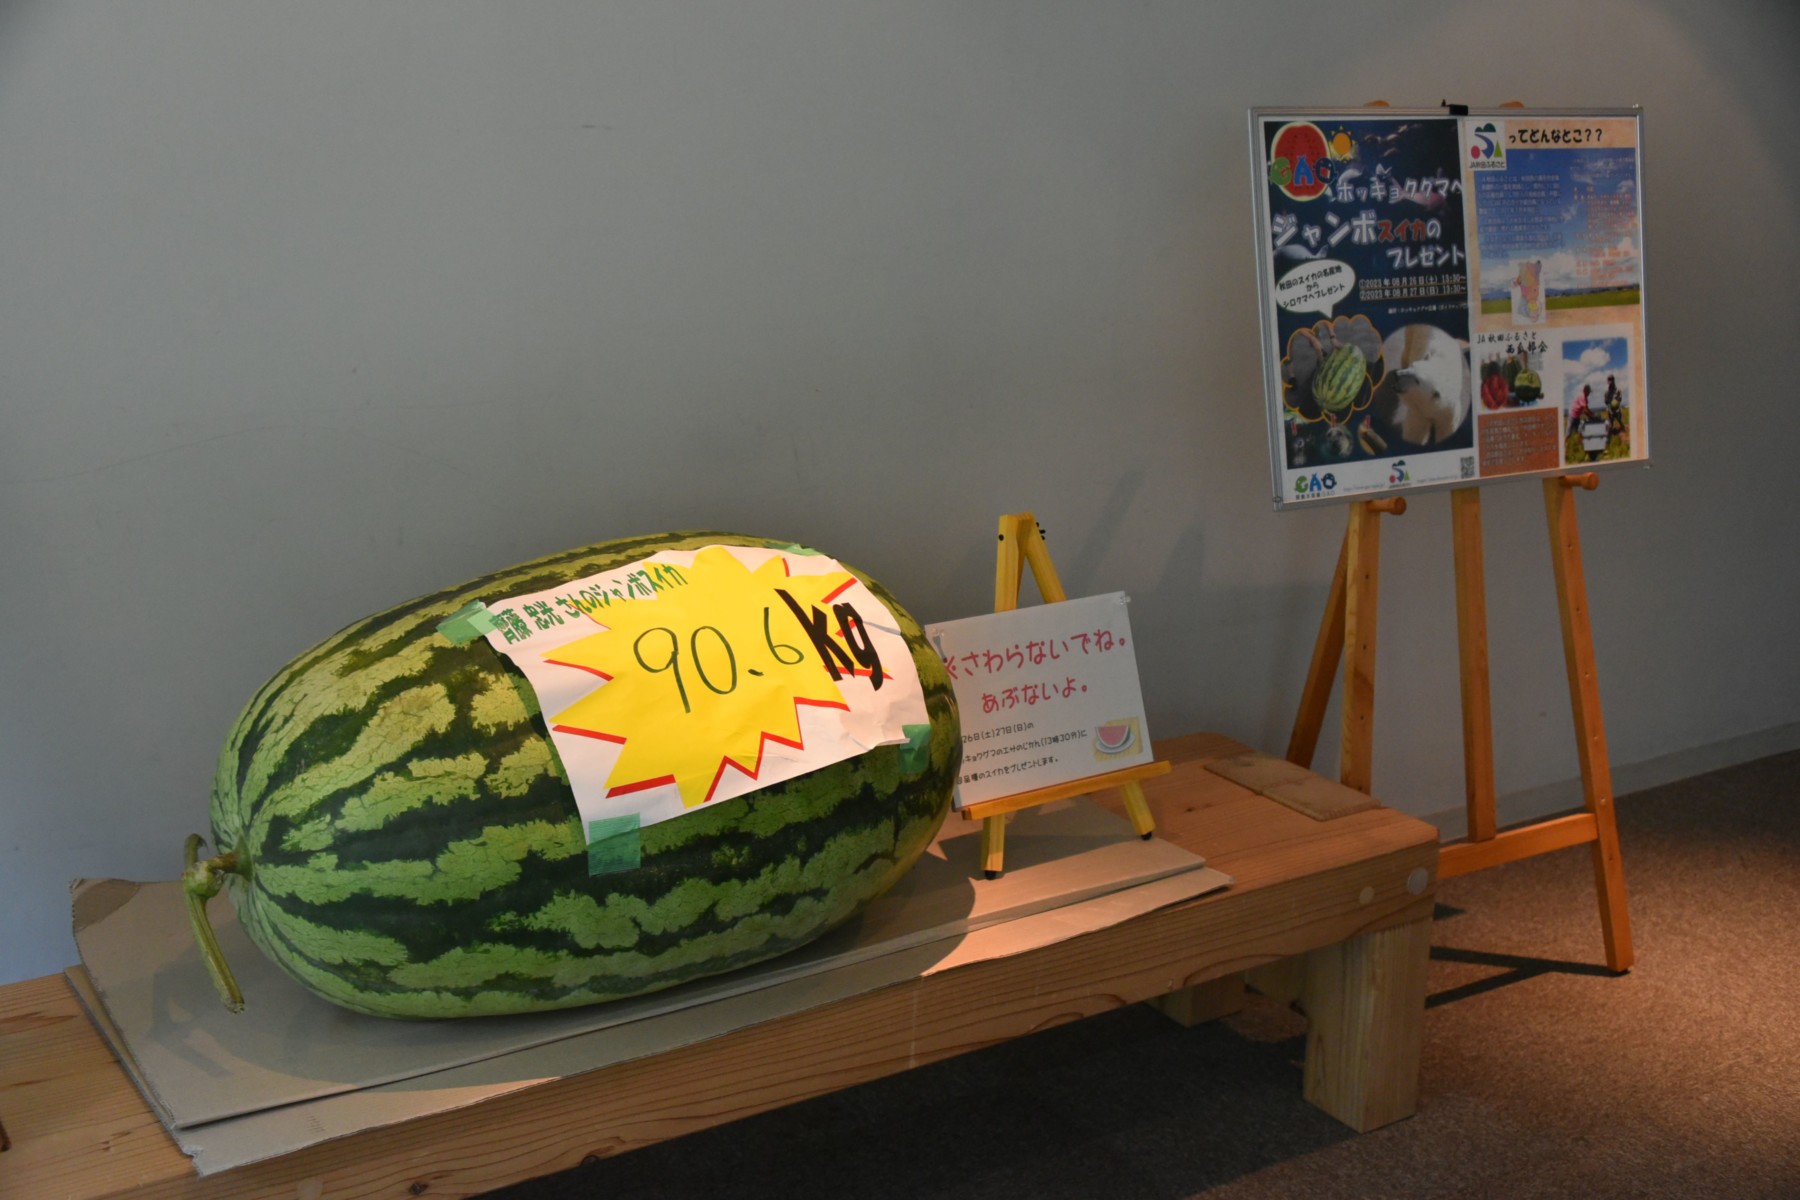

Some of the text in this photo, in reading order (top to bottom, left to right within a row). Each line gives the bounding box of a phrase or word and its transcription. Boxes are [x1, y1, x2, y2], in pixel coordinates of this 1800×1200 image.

[1273, 210, 1442, 247] ジャンボスイカの
[981, 677, 1089, 714] あぶないよ。
